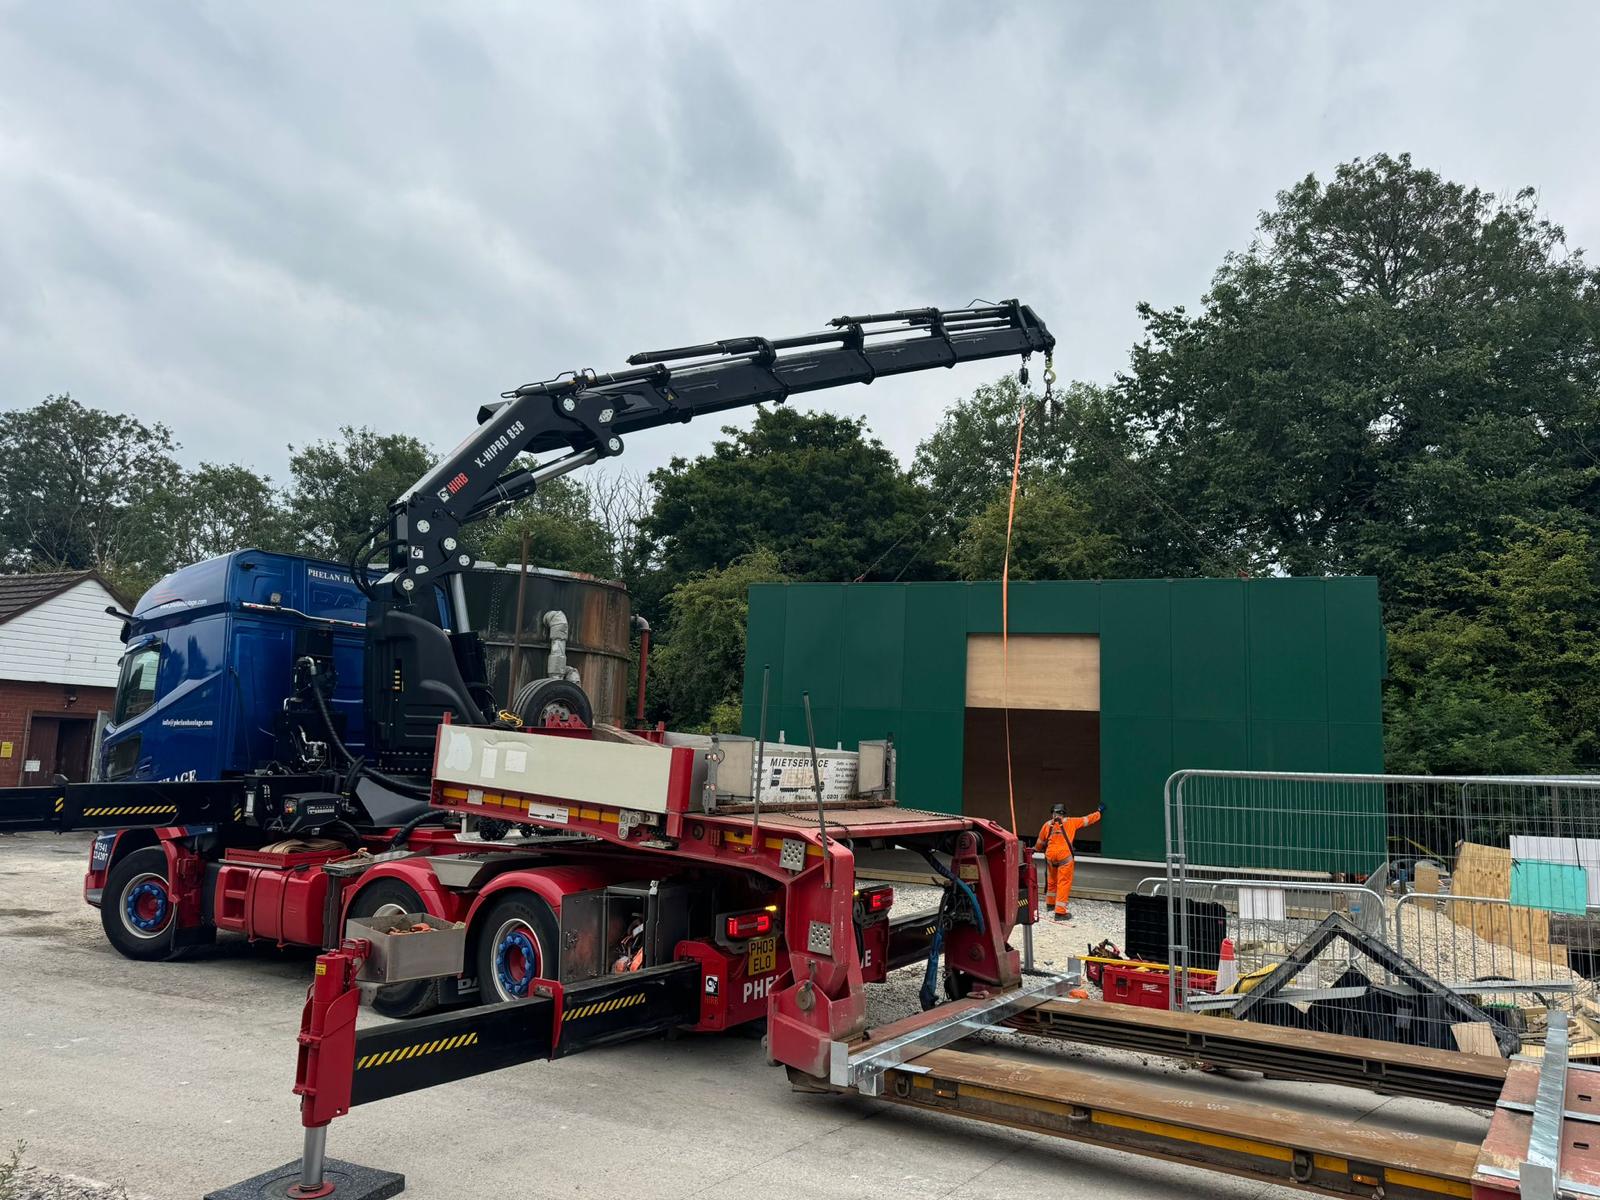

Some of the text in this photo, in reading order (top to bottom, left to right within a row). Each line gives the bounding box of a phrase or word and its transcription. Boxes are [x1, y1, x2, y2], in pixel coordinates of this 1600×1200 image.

[474, 420, 525, 469] X-HIPRO 858
[446, 472, 469, 494] HIAB
[307, 568, 341, 581] PHELAN
[770, 757, 829, 768] MIETSERVCE
[750, 939, 774, 956] PH03
[743, 974, 780, 1003] PHE
